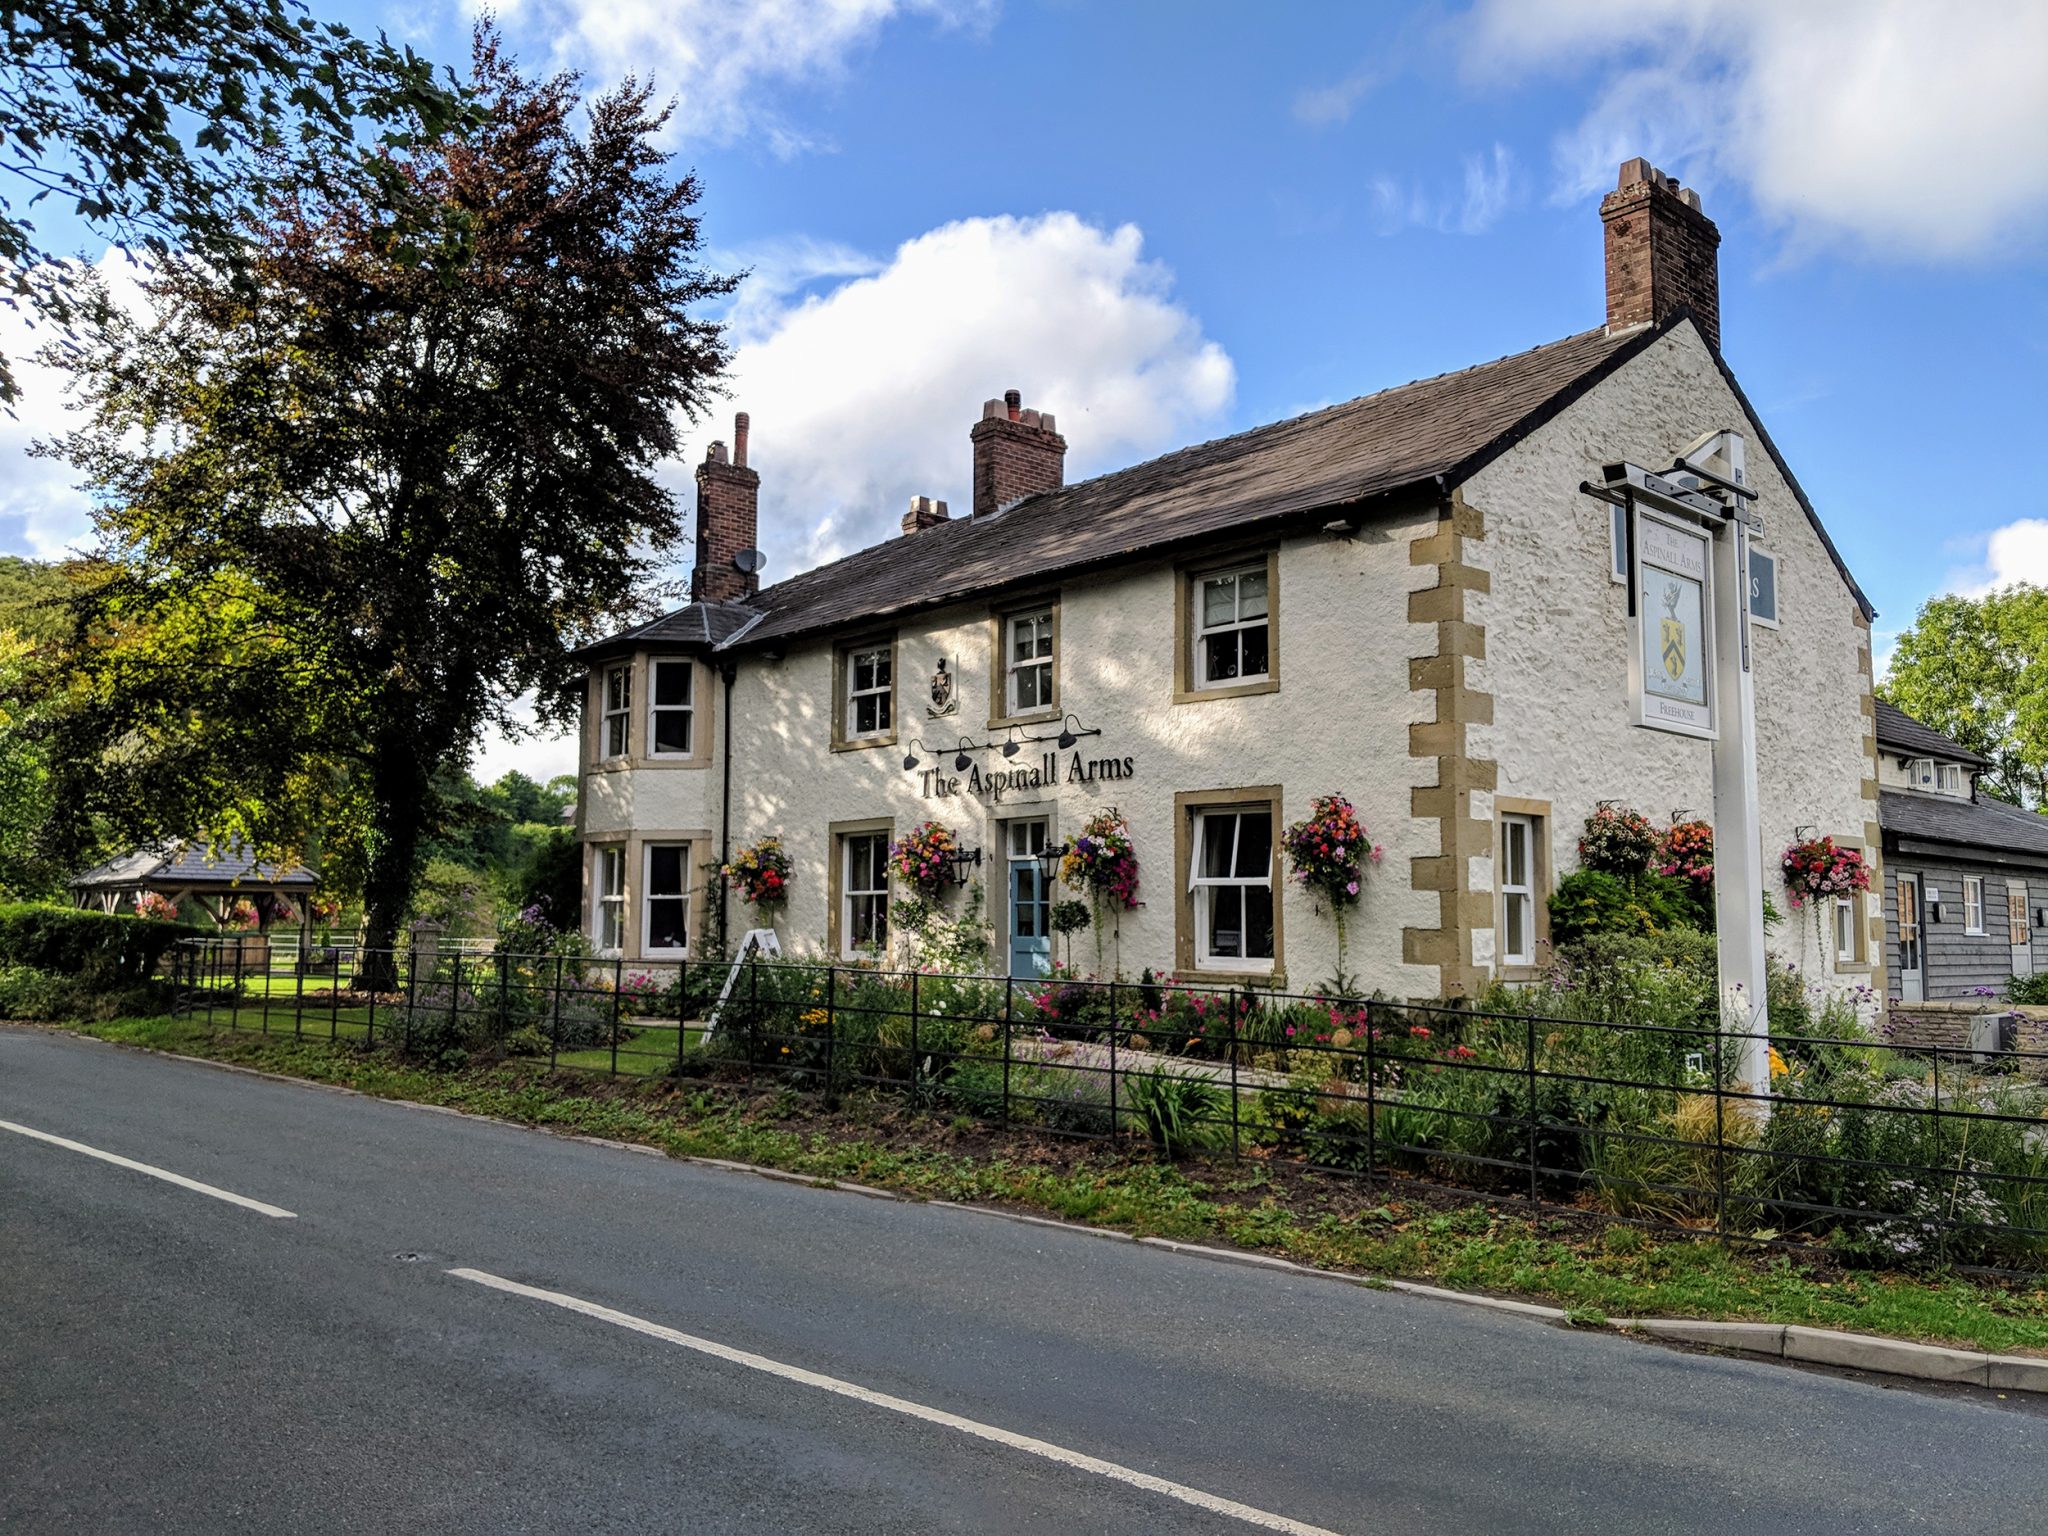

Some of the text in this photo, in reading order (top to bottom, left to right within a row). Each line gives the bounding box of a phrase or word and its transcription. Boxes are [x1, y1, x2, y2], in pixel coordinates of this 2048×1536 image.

[1665, 533, 1679, 548] THE
[1643, 540, 1702, 573] ASPINALL ARMS
[1660, 701, 1696, 721] FREEHOUSE
[917, 750, 1135, 801] The Aspinall Arms
